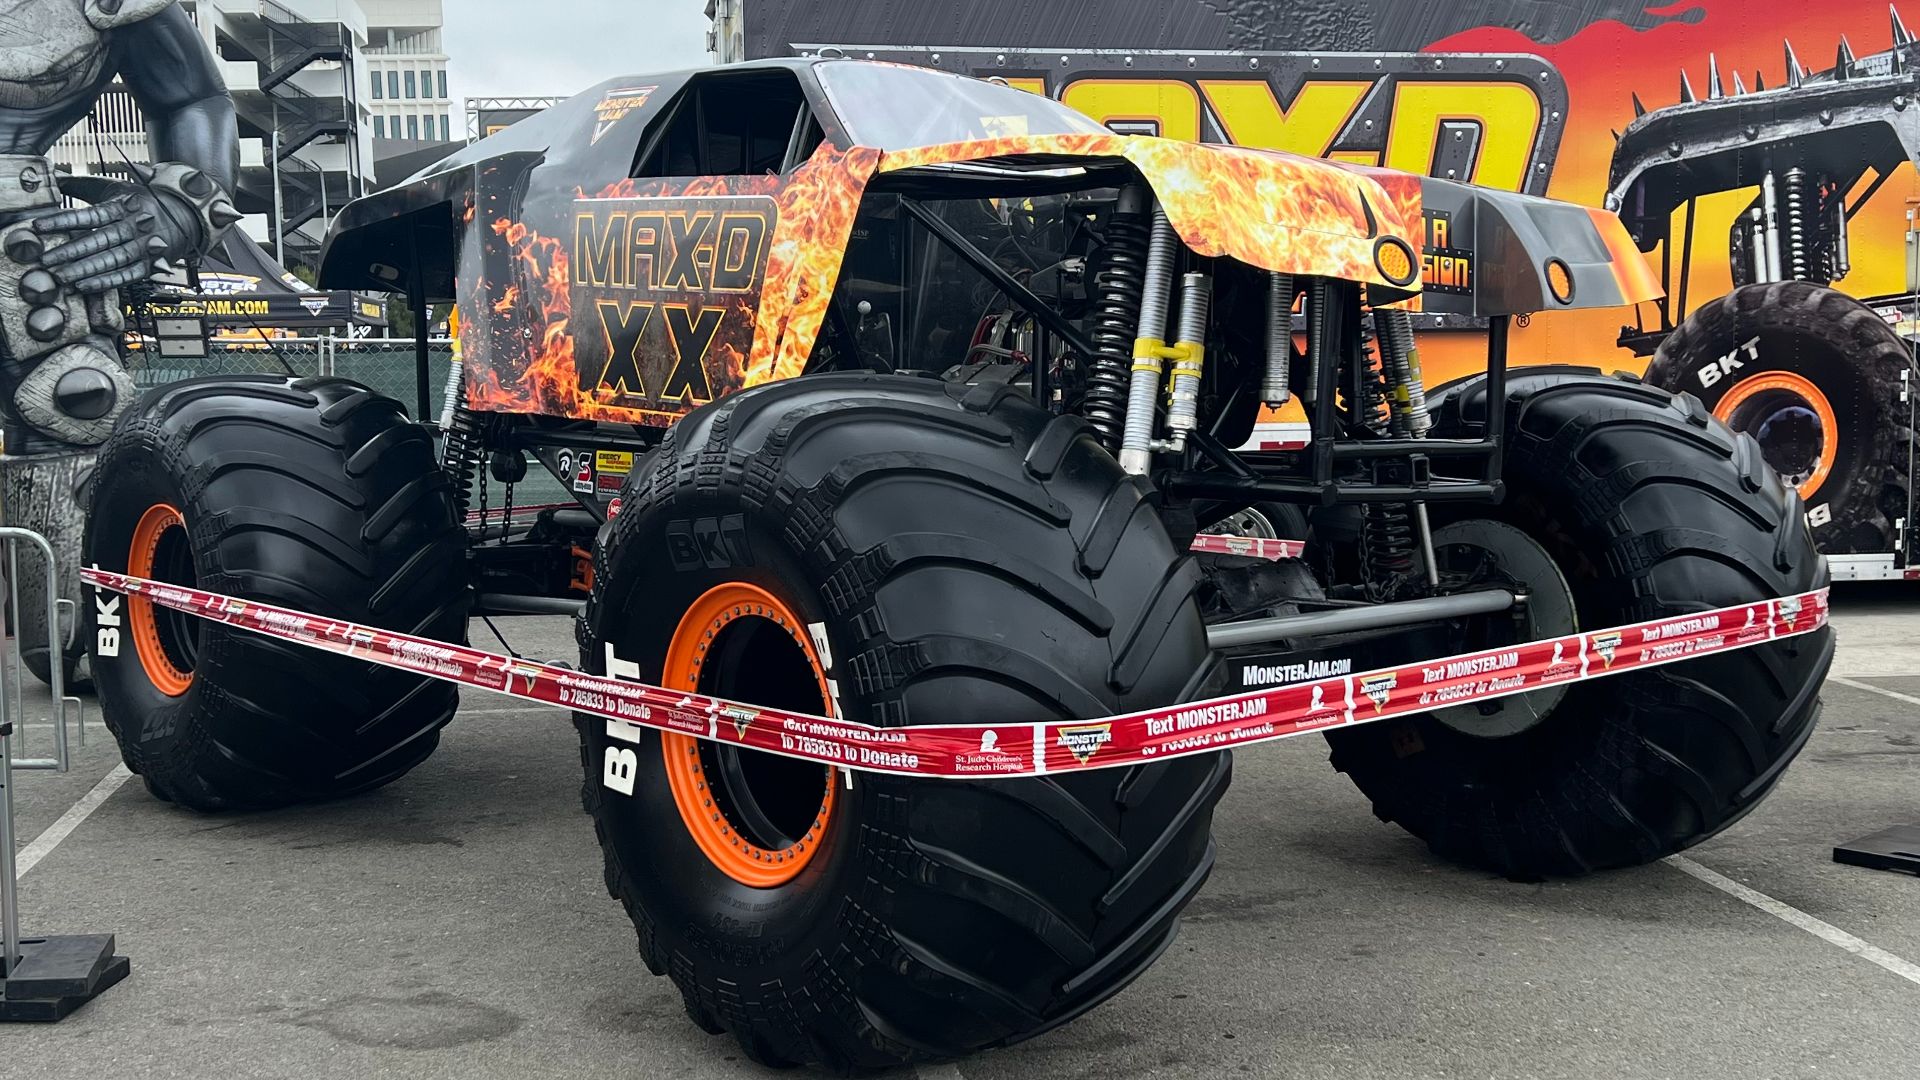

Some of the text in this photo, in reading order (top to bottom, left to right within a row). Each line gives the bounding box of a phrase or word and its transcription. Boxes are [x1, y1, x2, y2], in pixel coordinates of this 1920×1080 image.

[1855, 53, 1906, 70] MONSTR
[1868, 63, 1891, 75] JAM
[575, 212, 768, 293] MAX-D
[1697, 336, 1761, 389] BKT
[1641, 627, 1661, 642] Text
[1661, 615, 1720, 638] MONSTERJAM
[1422, 666, 1445, 684] Text
[1446, 652, 1519, 680] MONSTERJAM
[1360, 679, 1398, 694] MONSTER
[560, 686, 651, 720] to 785833 to Donate
[1144, 698, 1267, 737] Text MONSTERJAM
[780, 733, 919, 769] to 785833 to Donate
[1057, 732, 1112, 747] MONSTER
[956, 755, 966, 763] St.
[968, 755, 986, 764] Jude
[956, 763, 992, 772] Research
